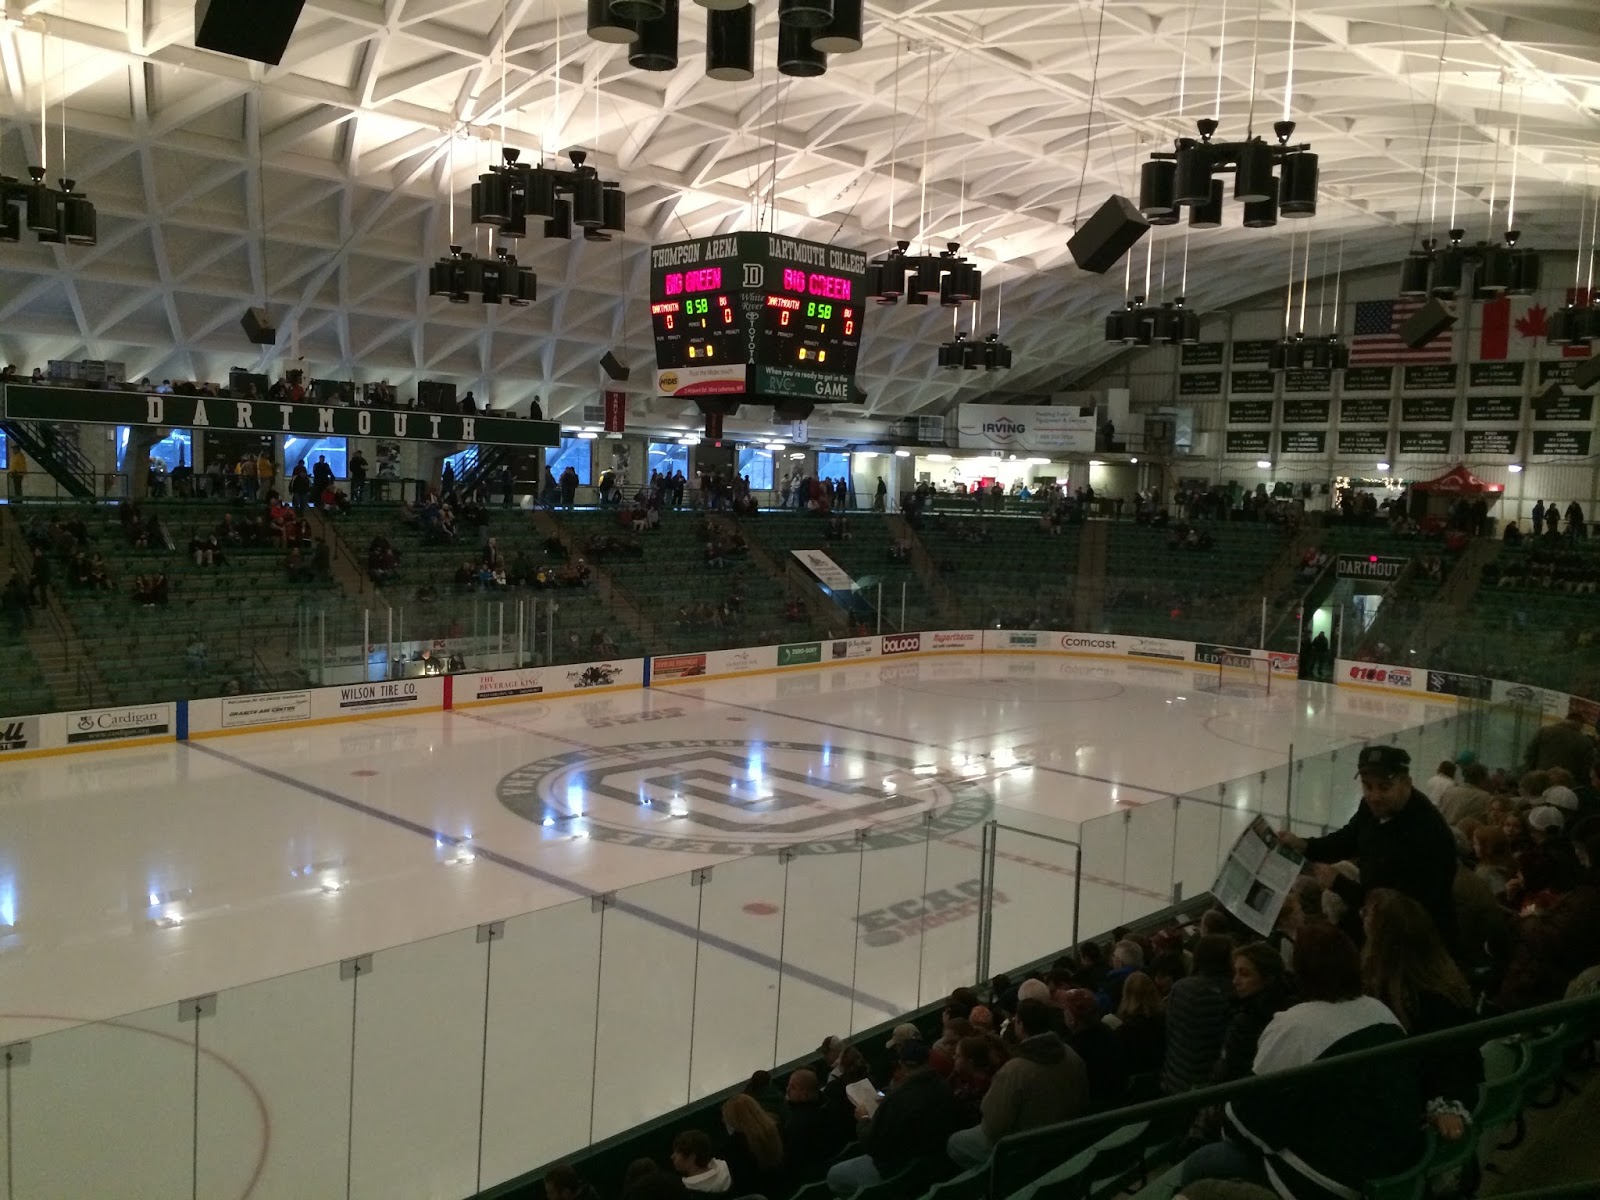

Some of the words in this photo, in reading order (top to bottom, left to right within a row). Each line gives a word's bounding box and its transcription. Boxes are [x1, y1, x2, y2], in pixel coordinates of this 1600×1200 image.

[652, 243, 700, 268] THOMPSON
[705, 237, 738, 260] ARENA
[769, 237, 825, 267] DARTMOUTH
[830, 250, 866, 274] COLLEGE
[666, 273, 683, 295] BIG
[685, 267, 722, 293] GREEN
[784, 268, 805, 292] BIG
[808, 274, 851, 300] GREEN
[740, 293, 764, 302] White
[767, 296, 800, 310] DARTMOUTH
[652, 302, 680, 314] DARTMOUTH
[742, 302, 764, 311] River
[844, 308, 852, 318] BU
[666, 314, 674, 329] 0
[724, 308, 732, 324] 0
[781, 310, 790, 326] 0
[845, 320, 853, 335] 0
[766, 366, 782, 376] When
[783, 368, 800, 378] you're
[801, 371, 817, 380] ready
[770, 376, 791, 391] RVC
[815, 381, 848, 397] GAME
[147, 396, 476, 441] DARTMOUTH
[982, 423, 1026, 434] IRVING
[1338, 560, 1400, 576] DARTMOUT
[432, 640, 446, 648] PG
[1063, 636, 1117, 649] comcast
[341, 687, 375, 700] WILSON
[380, 684, 398, 696] TIRE
[404, 683, 417, 694] CO.
[480, 681, 518, 690] BEVERAGE
[97, 712, 157, 728] Cardigan
